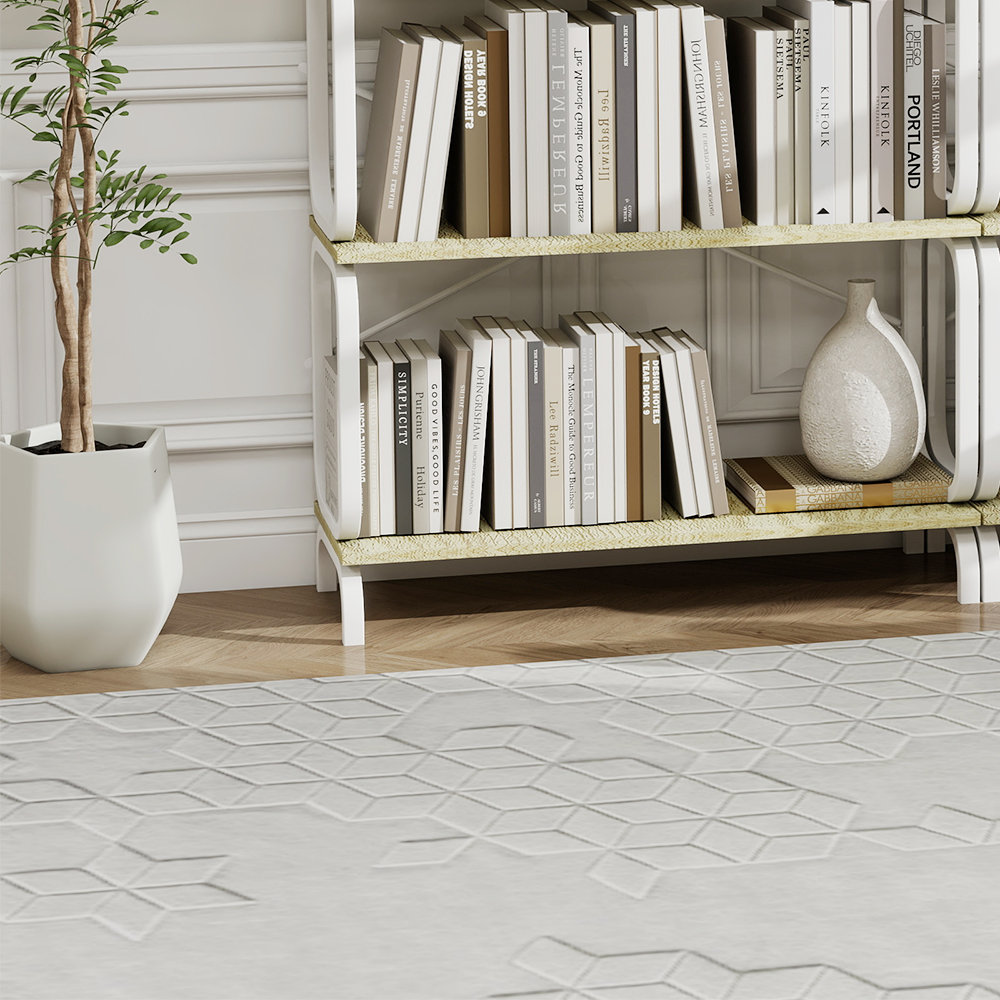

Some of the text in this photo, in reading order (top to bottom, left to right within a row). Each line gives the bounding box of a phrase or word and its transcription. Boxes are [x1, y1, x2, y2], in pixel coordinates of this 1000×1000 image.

[776, 38, 784, 99] SIETSEMA
[785, 38, 793, 70] PAUL
[794, 28, 802, 92] SIETSEMA
[802, 28, 810, 61] PAUL
[905, 24, 914, 72] UCHITEL
[913, 30, 921, 66] DIEGO
[931, 69, 940, 100] LESLIE
[820, 86, 830, 147] KINFOLK
[880, 85, 890, 147] KINFOLK
[907, 95, 921, 189] PORTLAND
[642, 360, 650, 382] YEAR
[642, 384, 651, 408] BOOK
[652, 360, 660, 425] DESIGN HOTELS
[397, 371, 408, 446] SIMPLICITY
[472, 366, 486, 441] JOHNGRISHAM
[414, 392, 426, 509] Purienne Holiday
[549, 401, 560, 477] Lee Radziwill
[583, 378, 595, 501] LEMPEREUR
